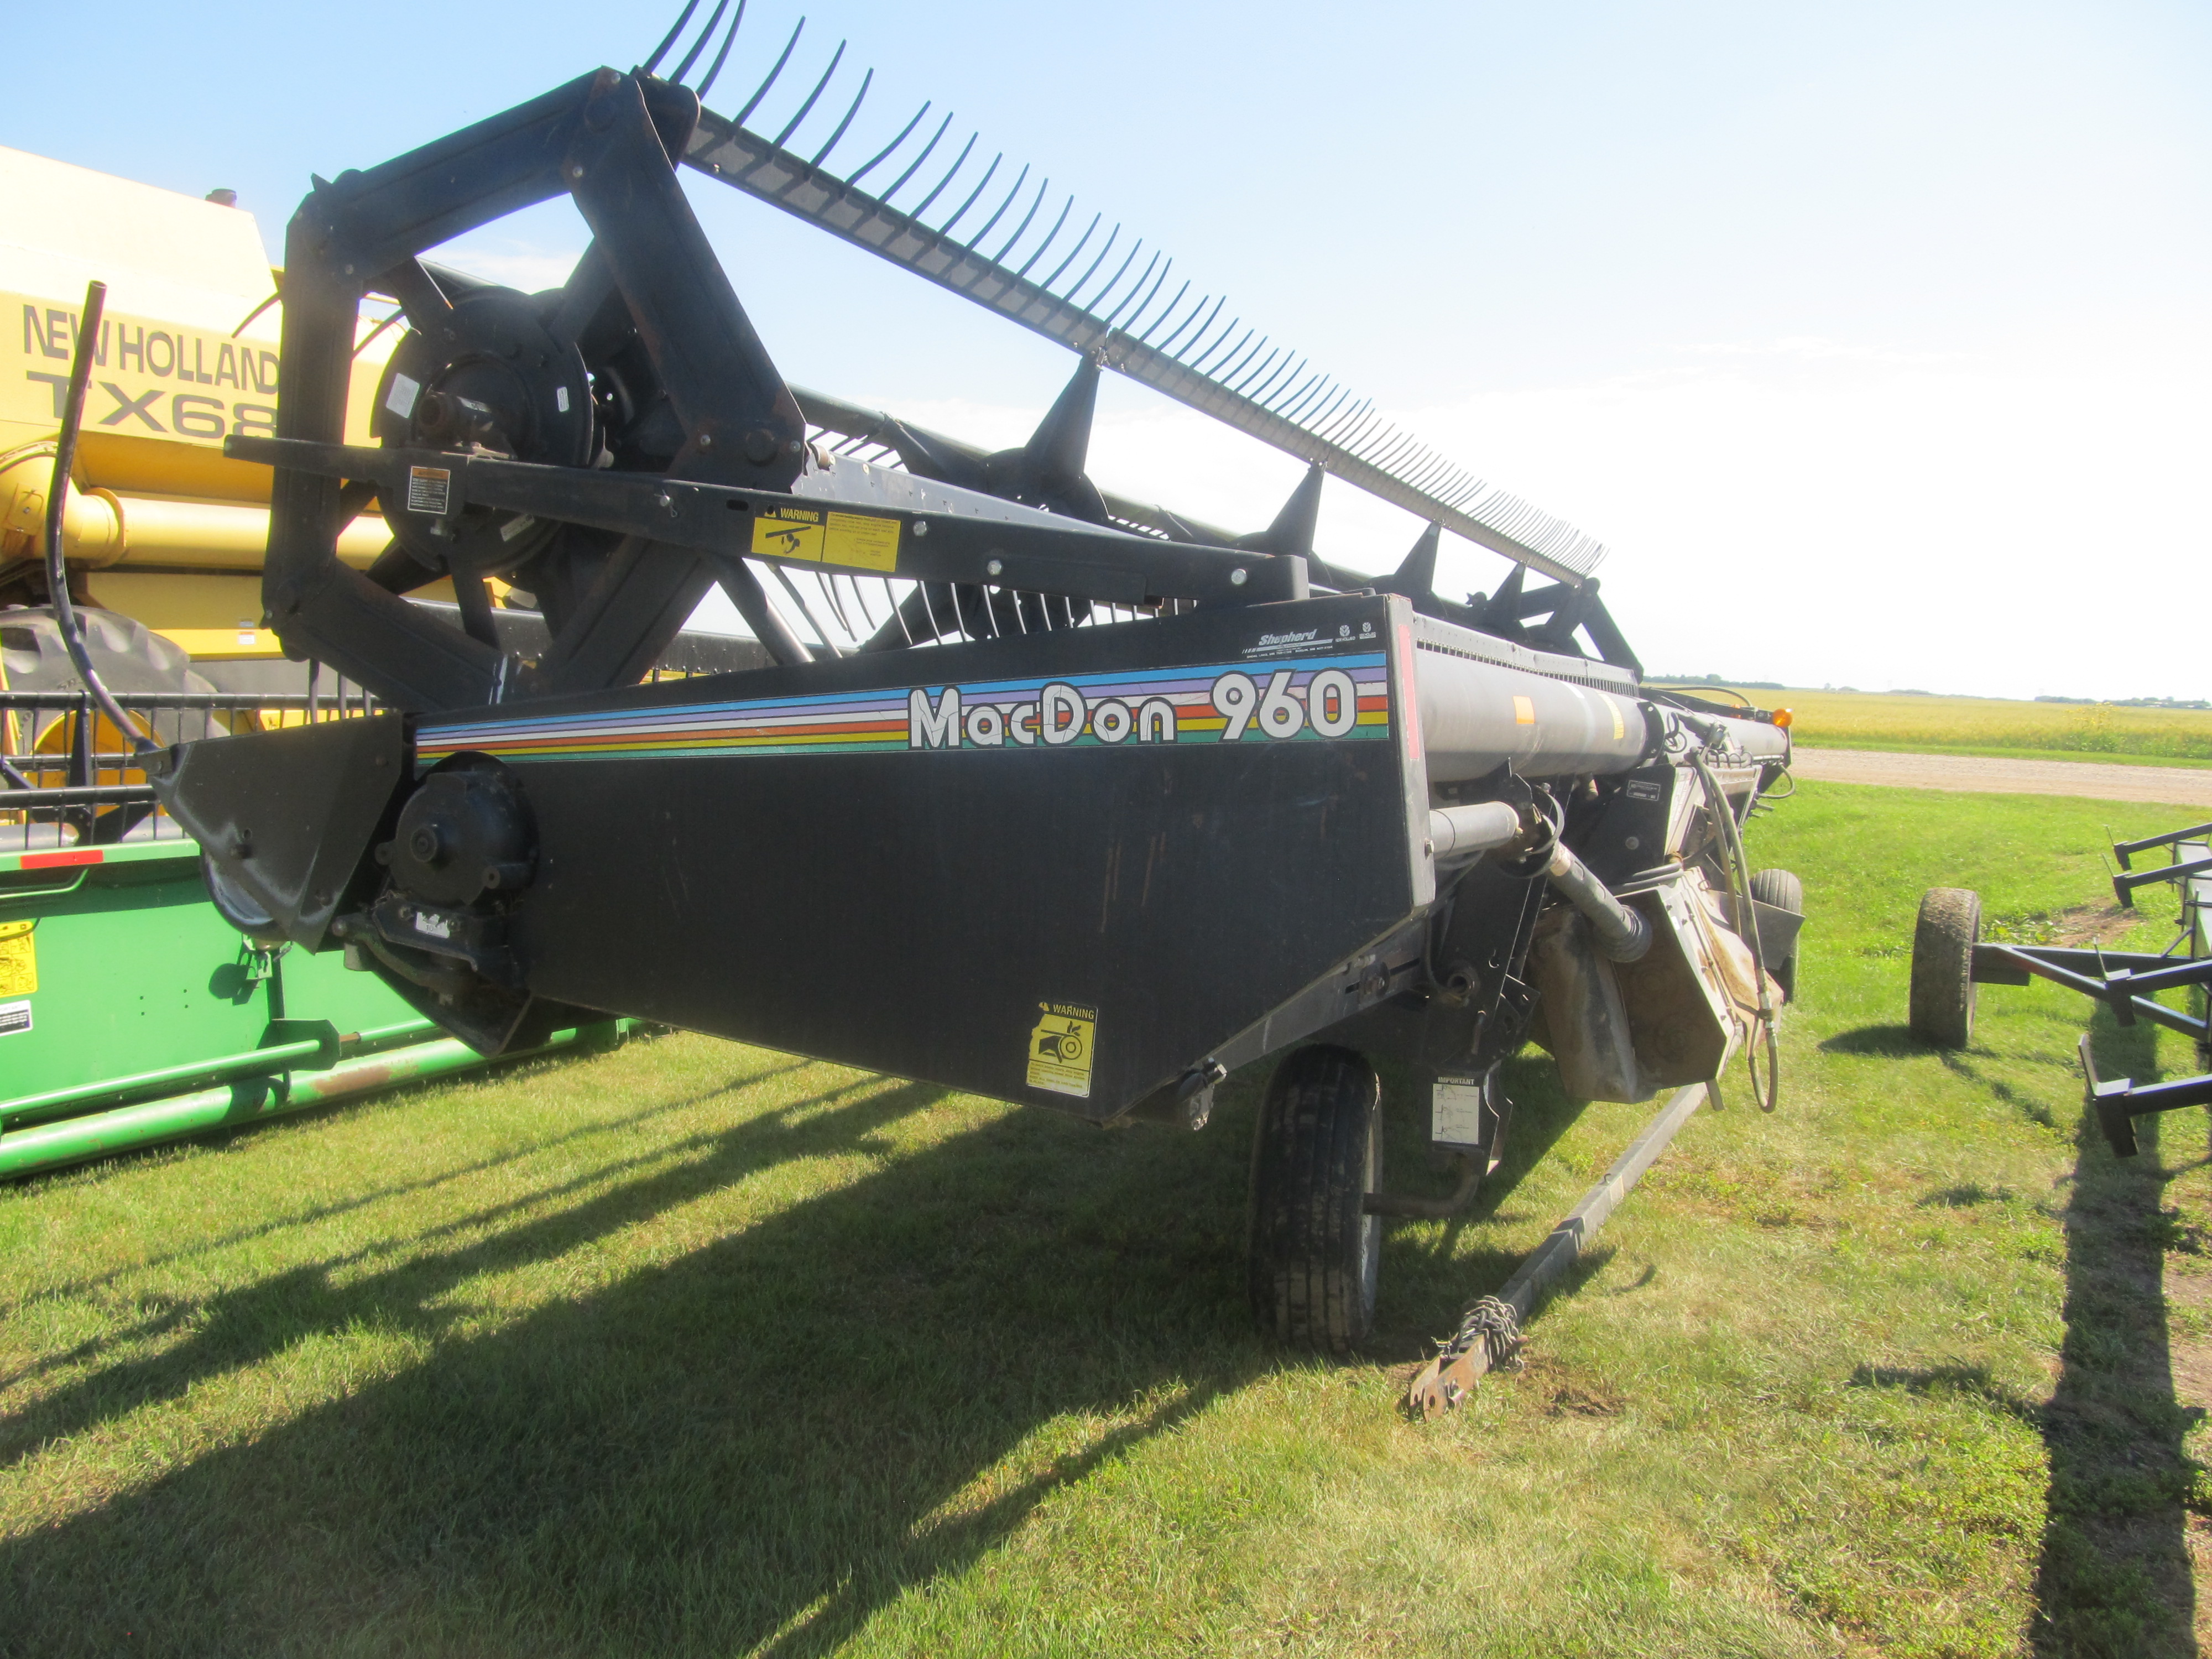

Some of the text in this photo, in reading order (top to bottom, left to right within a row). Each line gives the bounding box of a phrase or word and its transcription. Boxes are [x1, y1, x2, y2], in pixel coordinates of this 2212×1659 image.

[118, 323, 279, 394] HOLLAND
[27, 371, 277, 439] TX68
[780, 508, 818, 522] WARNING
[1259, 629, 1317, 646] Shepherd
[908, 666, 1358, 749] MacDon 960
[1053, 1004, 1094, 1019] WARNING
[1438, 1077, 1474, 1085] IMPORTANT
